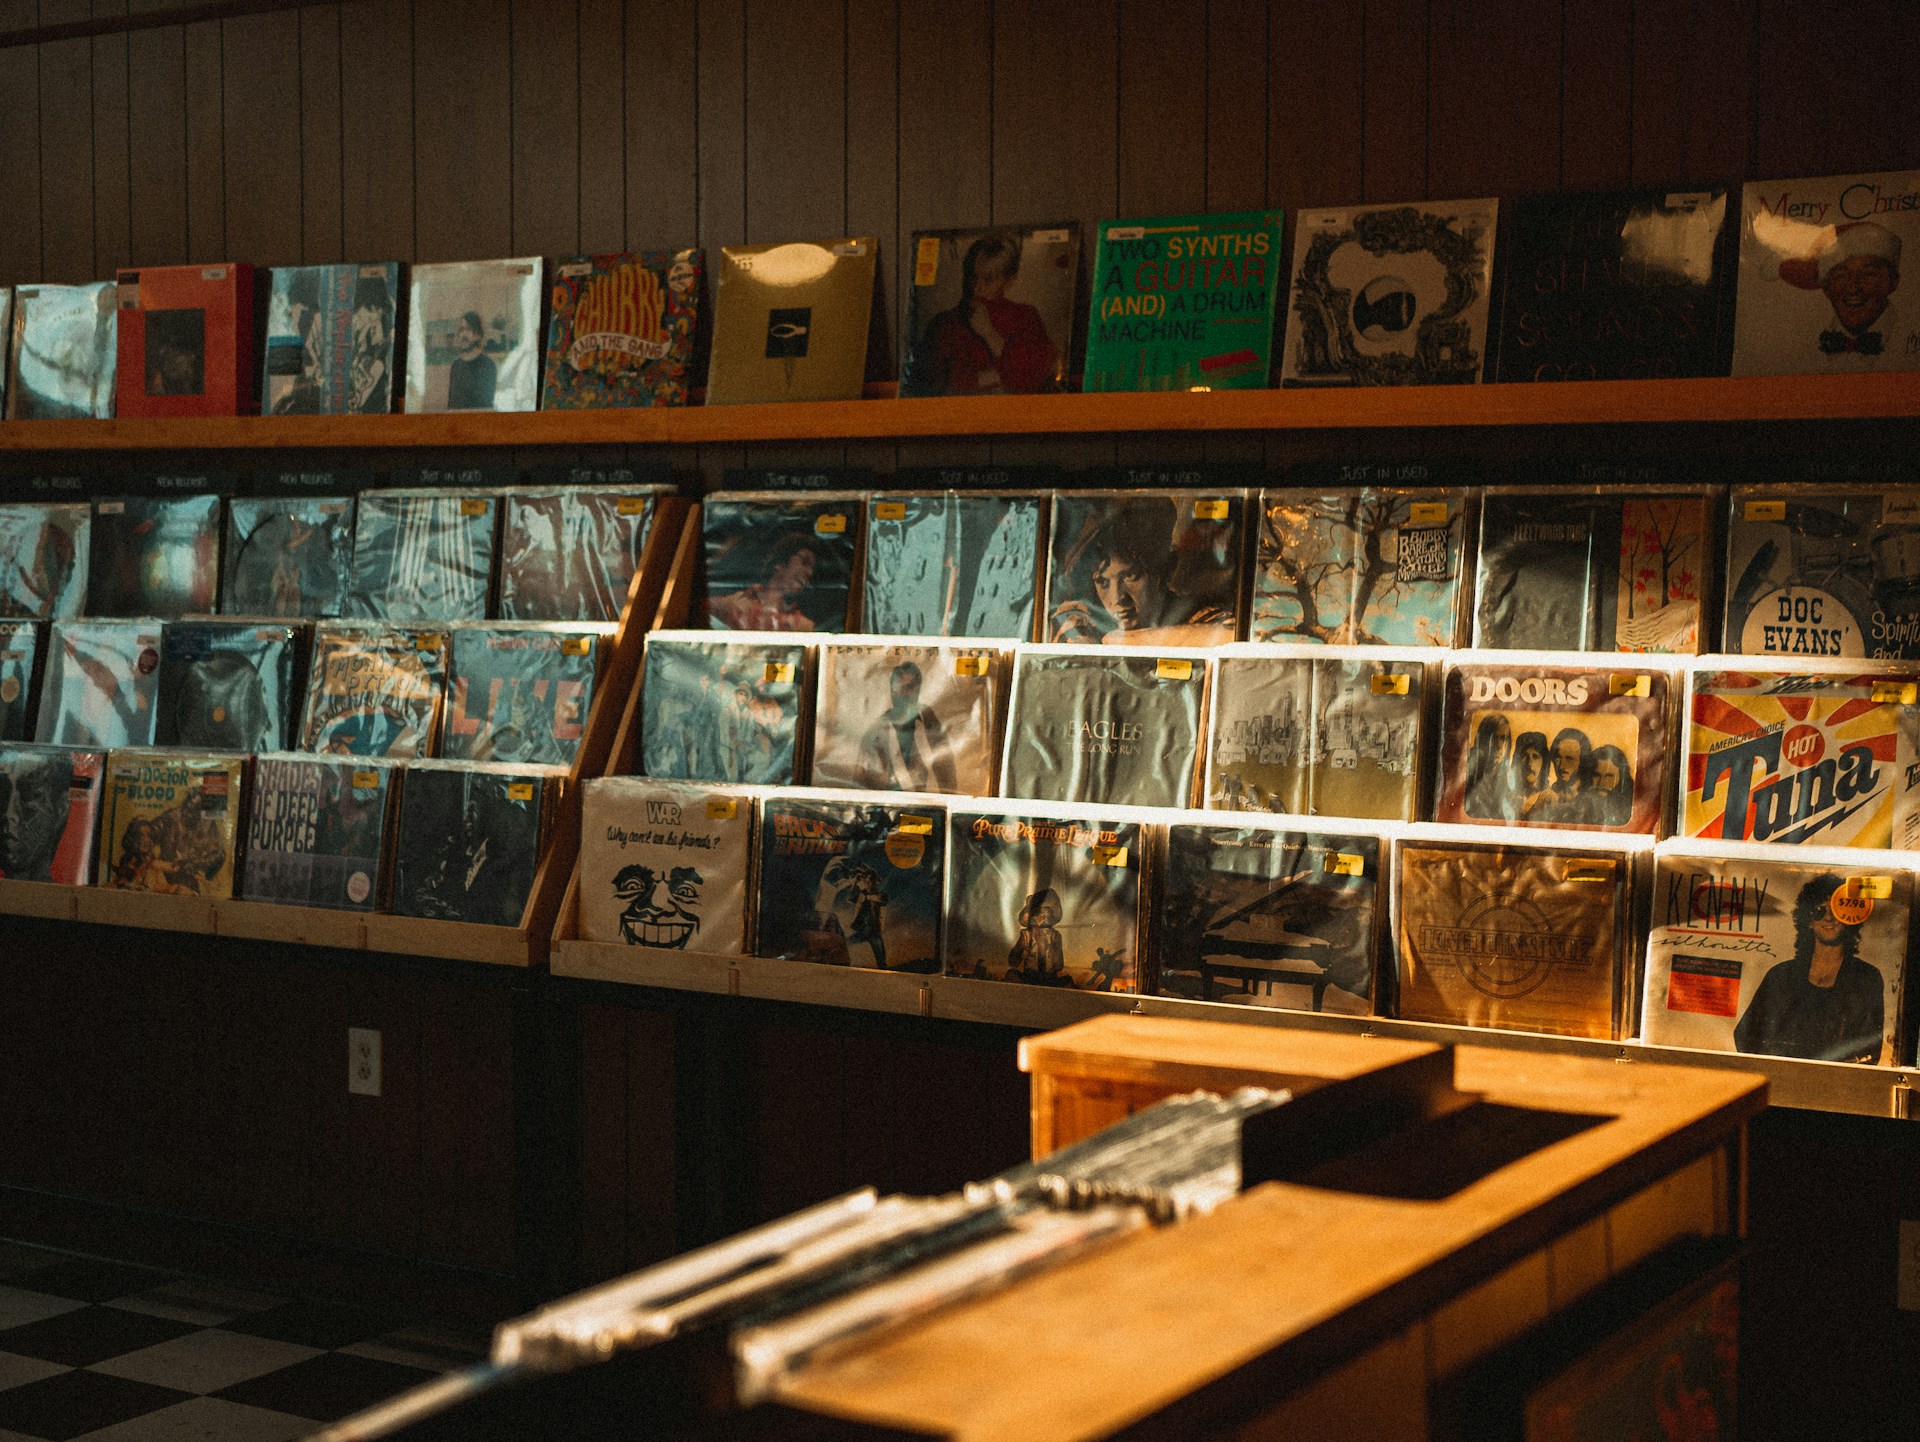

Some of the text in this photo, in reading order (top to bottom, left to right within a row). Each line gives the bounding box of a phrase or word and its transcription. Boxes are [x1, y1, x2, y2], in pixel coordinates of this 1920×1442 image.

[1759, 193, 1829, 224] Merry
[1106, 232, 1270, 261] TWO SYNTHS
[1104, 256, 1267, 293] A GUITAR
[573, 262, 665, 350] CHUBBY
[1101, 290, 1266, 321] (AND) A DRUM
[601, 335, 626, 348] THE
[1099, 318, 1207, 343] MACHINE
[1127, 470, 1201, 484] JUST IN USED
[1340, 465, 1429, 480] JUST IN USED
[1777, 596, 1823, 623] DOC
[1763, 626, 1850, 656] EVANS'
[1470, 676, 1589, 705] DOORS
[1067, 720, 1144, 741] EAGLES
[1708, 719, 1786, 754] AMERICA'S CHOICE
[1066, 742, 1084, 753] TE
[1788, 733, 1820, 760] HOT
[1701, 730, 1881, 842] Tuna
[645, 800, 682, 826] WAR
[773, 813, 830, 839] BACK
[249, 819, 318, 852] PURPLE
[607, 825, 628, 849] Why
[1665, 871, 1769, 933] KENNY
[1840, 913, 1862, 922] SALE
